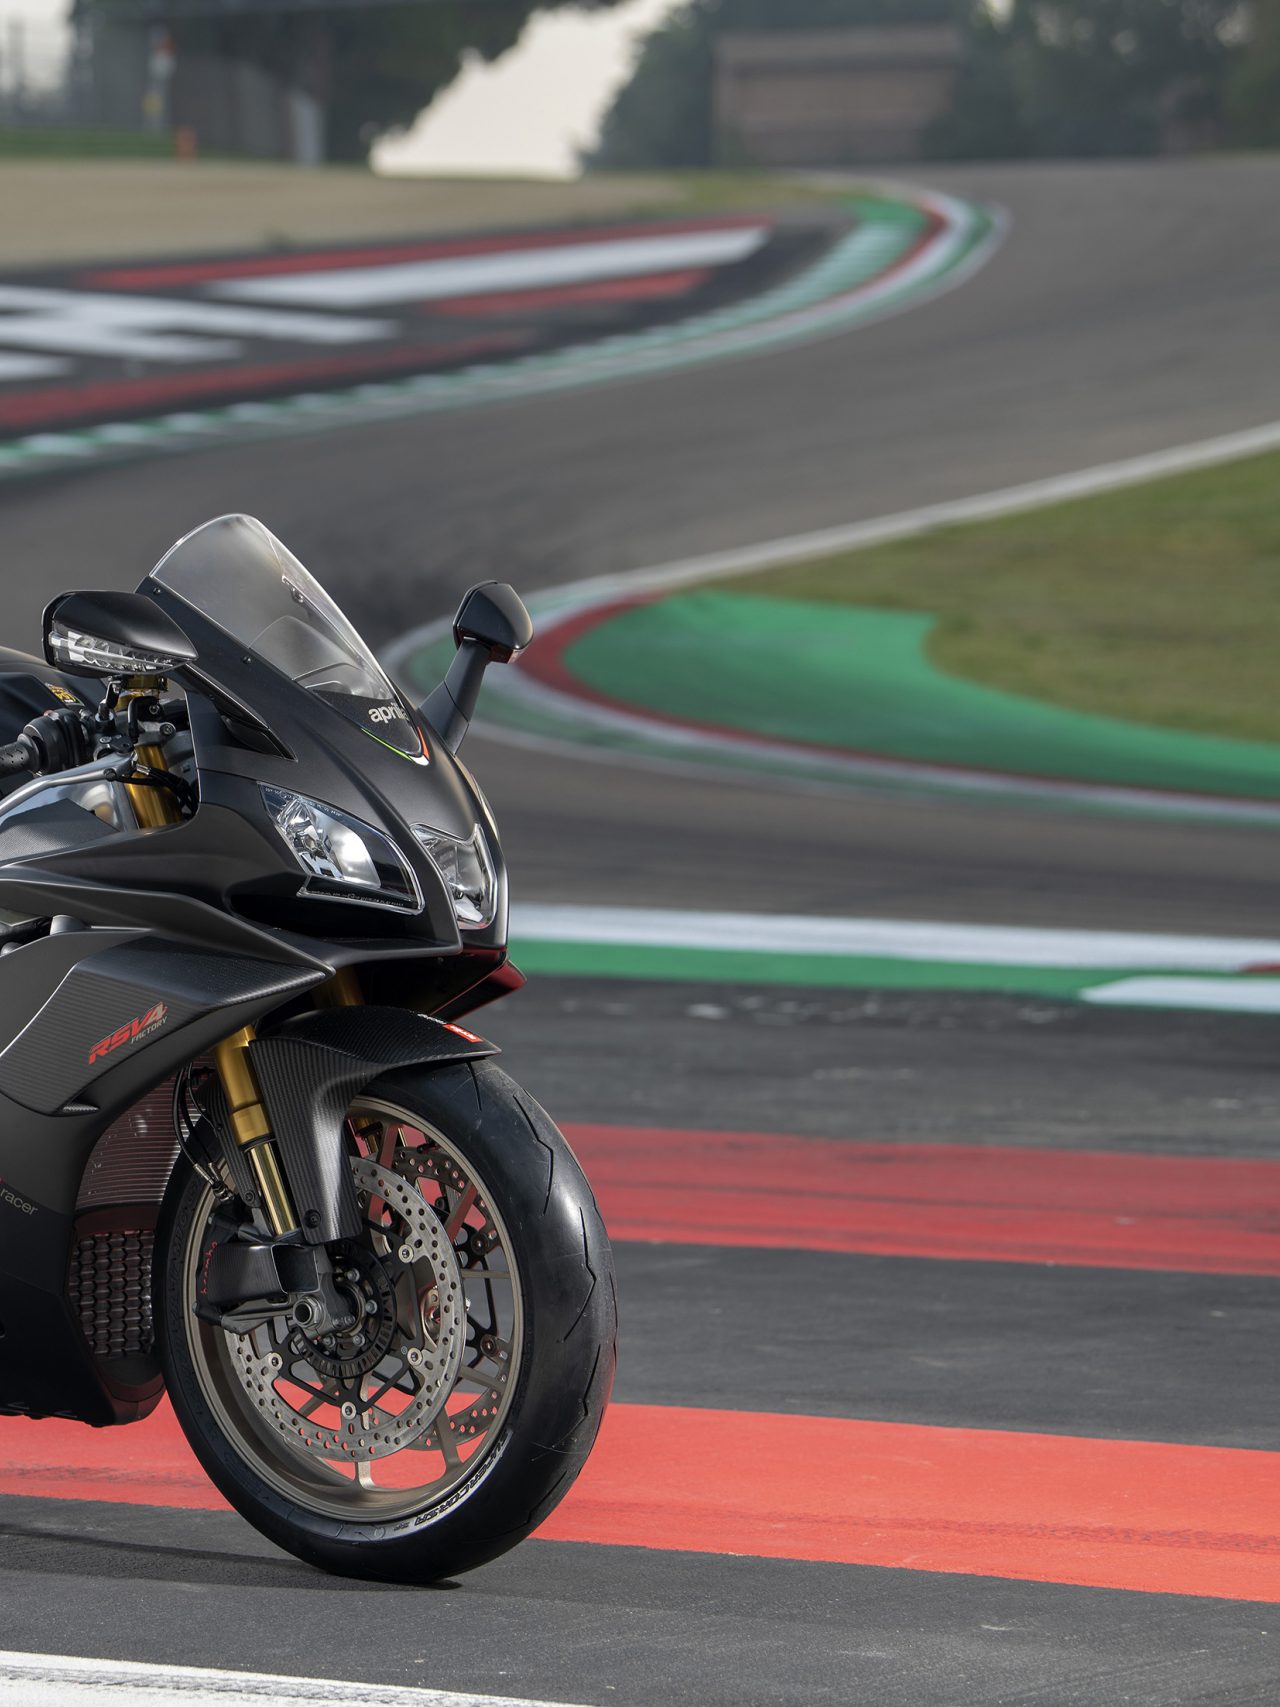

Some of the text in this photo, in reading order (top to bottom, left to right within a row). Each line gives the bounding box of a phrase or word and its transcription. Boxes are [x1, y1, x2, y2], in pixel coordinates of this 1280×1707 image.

[87, 1000, 168, 1066] RSV4
[130, 1015, 168, 1045] FACTORY
[0, 1187, 39, 1216] racer
